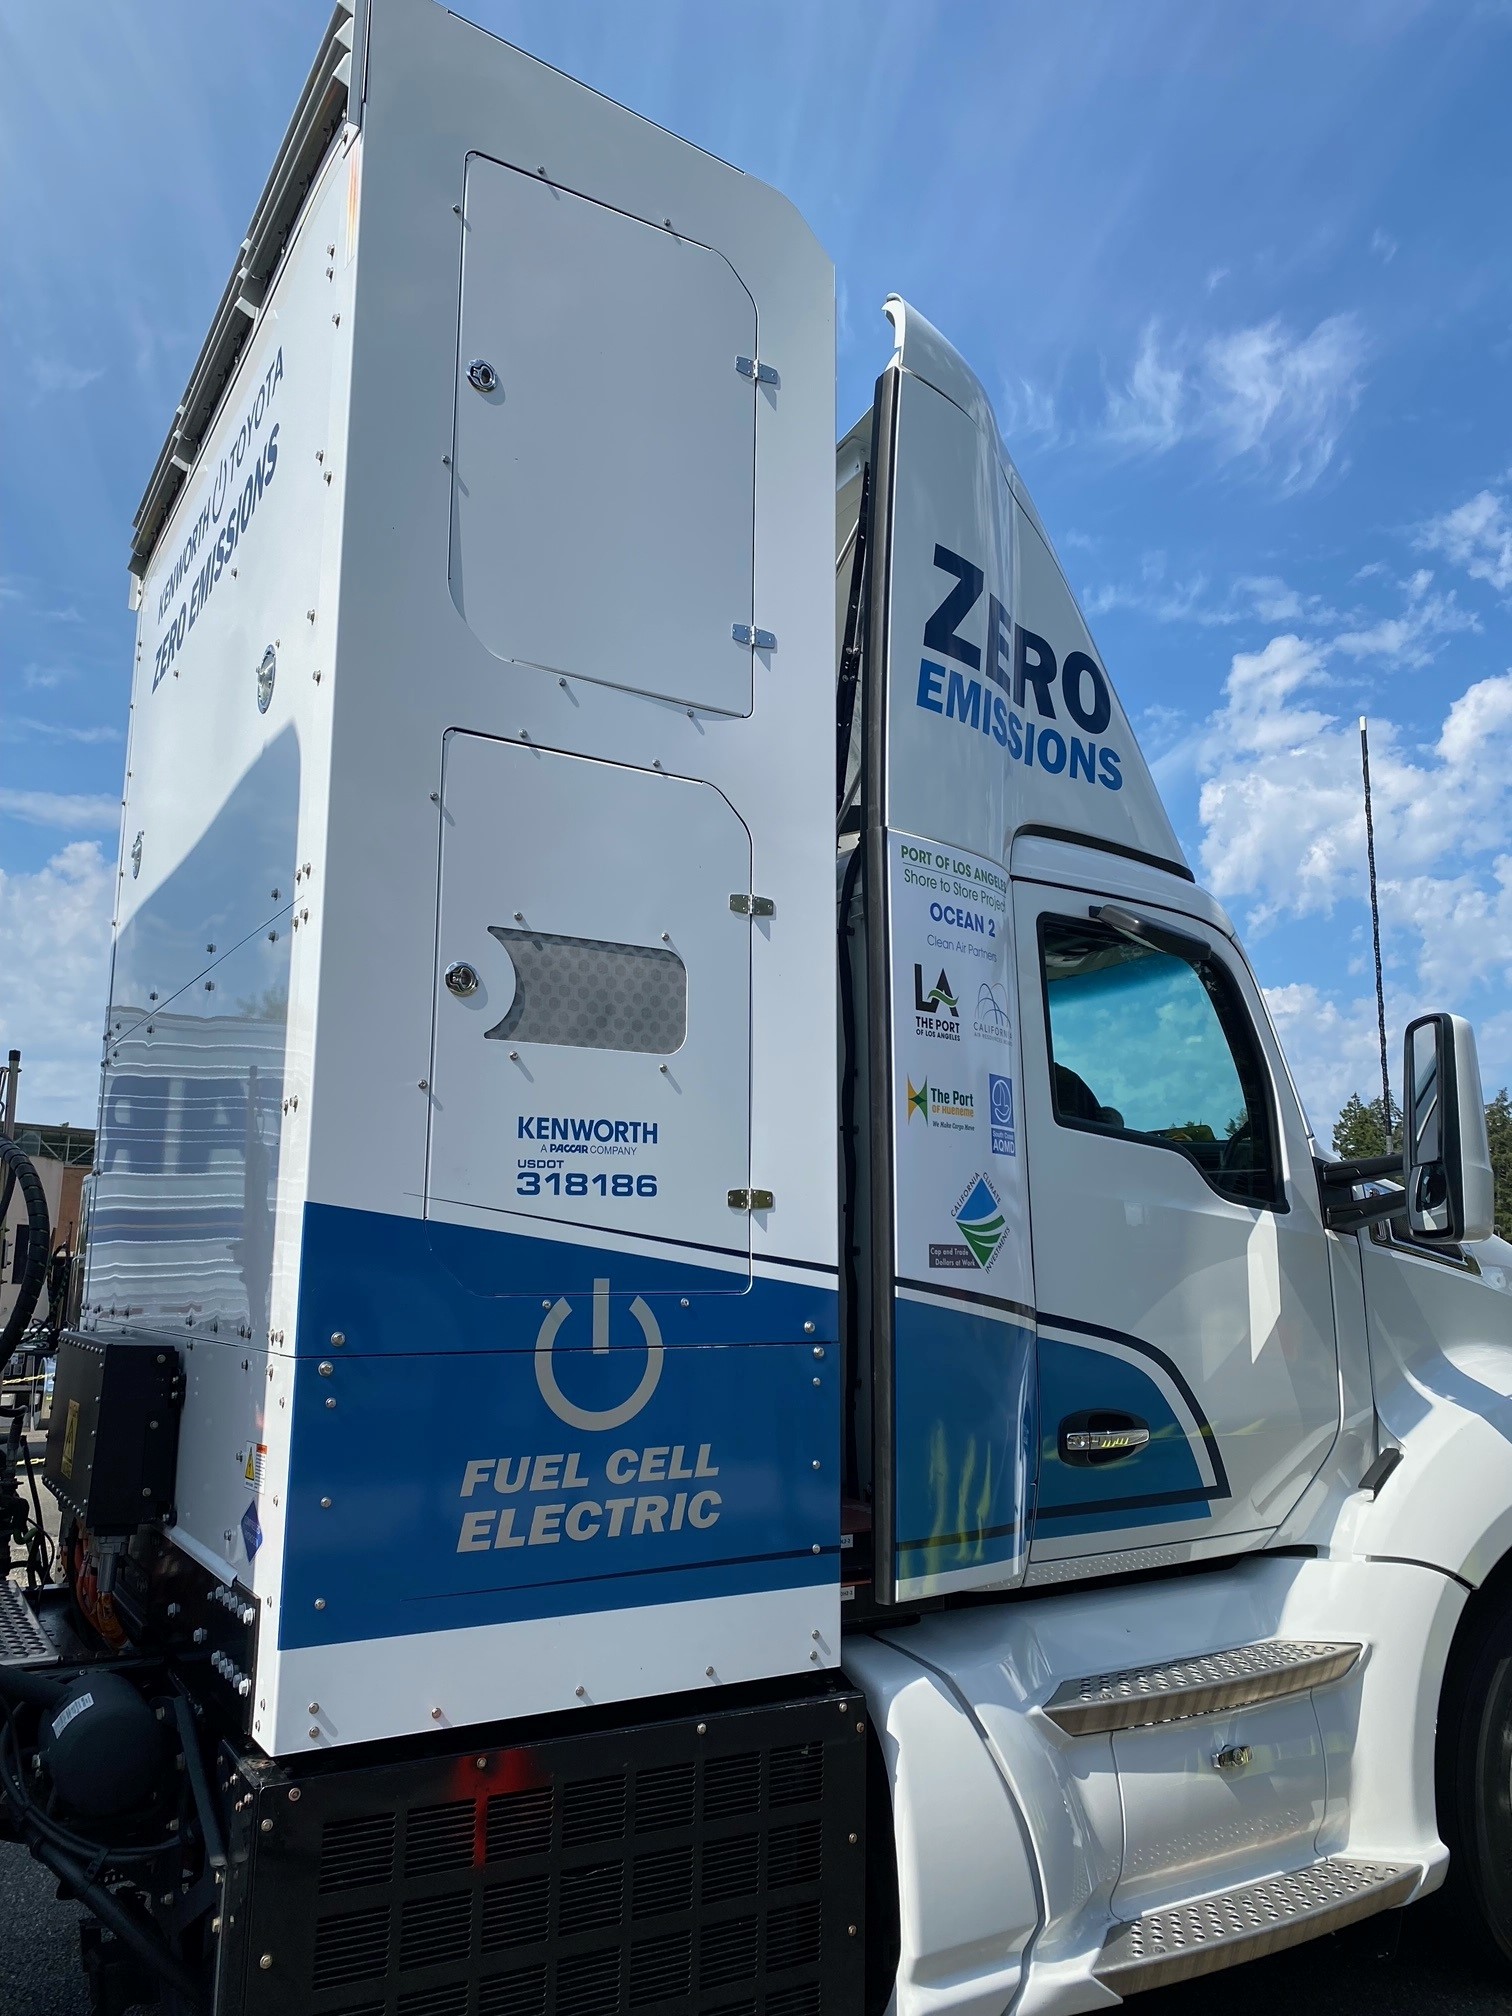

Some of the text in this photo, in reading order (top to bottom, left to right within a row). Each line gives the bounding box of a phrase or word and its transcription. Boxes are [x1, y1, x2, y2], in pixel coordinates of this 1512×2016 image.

[158, 346, 283, 625] KENWORTH TOYOTA
[151, 422, 280, 695] ZERO EMISSIONS
[923, 542, 1111, 735] ZERO
[916, 658, 1123, 791] EMISSIONS
[901, 844, 1007, 894] PORT OF LOS ANGELES
[904, 868, 937, 889] Shore
[940, 878, 951, 893] to
[953, 882, 979, 901] Store
[930, 902, 996, 938] OCEAN 2
[927, 934, 998, 963] Clean Air Partners
[914, 963, 960, 1018] LA
[915, 1016, 960, 1034] THE PORT
[915, 1028, 960, 1042] OF LOS ANGELES
[931, 1087, 974, 1107] The Port
[517, 1116, 658, 1144] KENWORTH
[940, 1121, 952, 1129] Make
[952, 1122, 964, 1131] Cargo
[540, 1143, 638, 1156] A PACCAR COMPANY
[993, 1138, 1015, 1153] AQMD
[517, 1159, 565, 1169] USDOT
[516, 1171, 658, 1197] 318186
[950, 1172, 1002, 1217] CALIFORNIA CLIMATE
[930, 1247, 969, 1257] Cap and Trade
[935, 1258, 954, 1267] Dollars
[961, 1259, 976, 1267] Work
[984, 1226, 1011, 1275] INVESTMENTS
[459, 1443, 720, 1498] FUEL CELL
[456, 1489, 723, 1553] ELECTRIC
